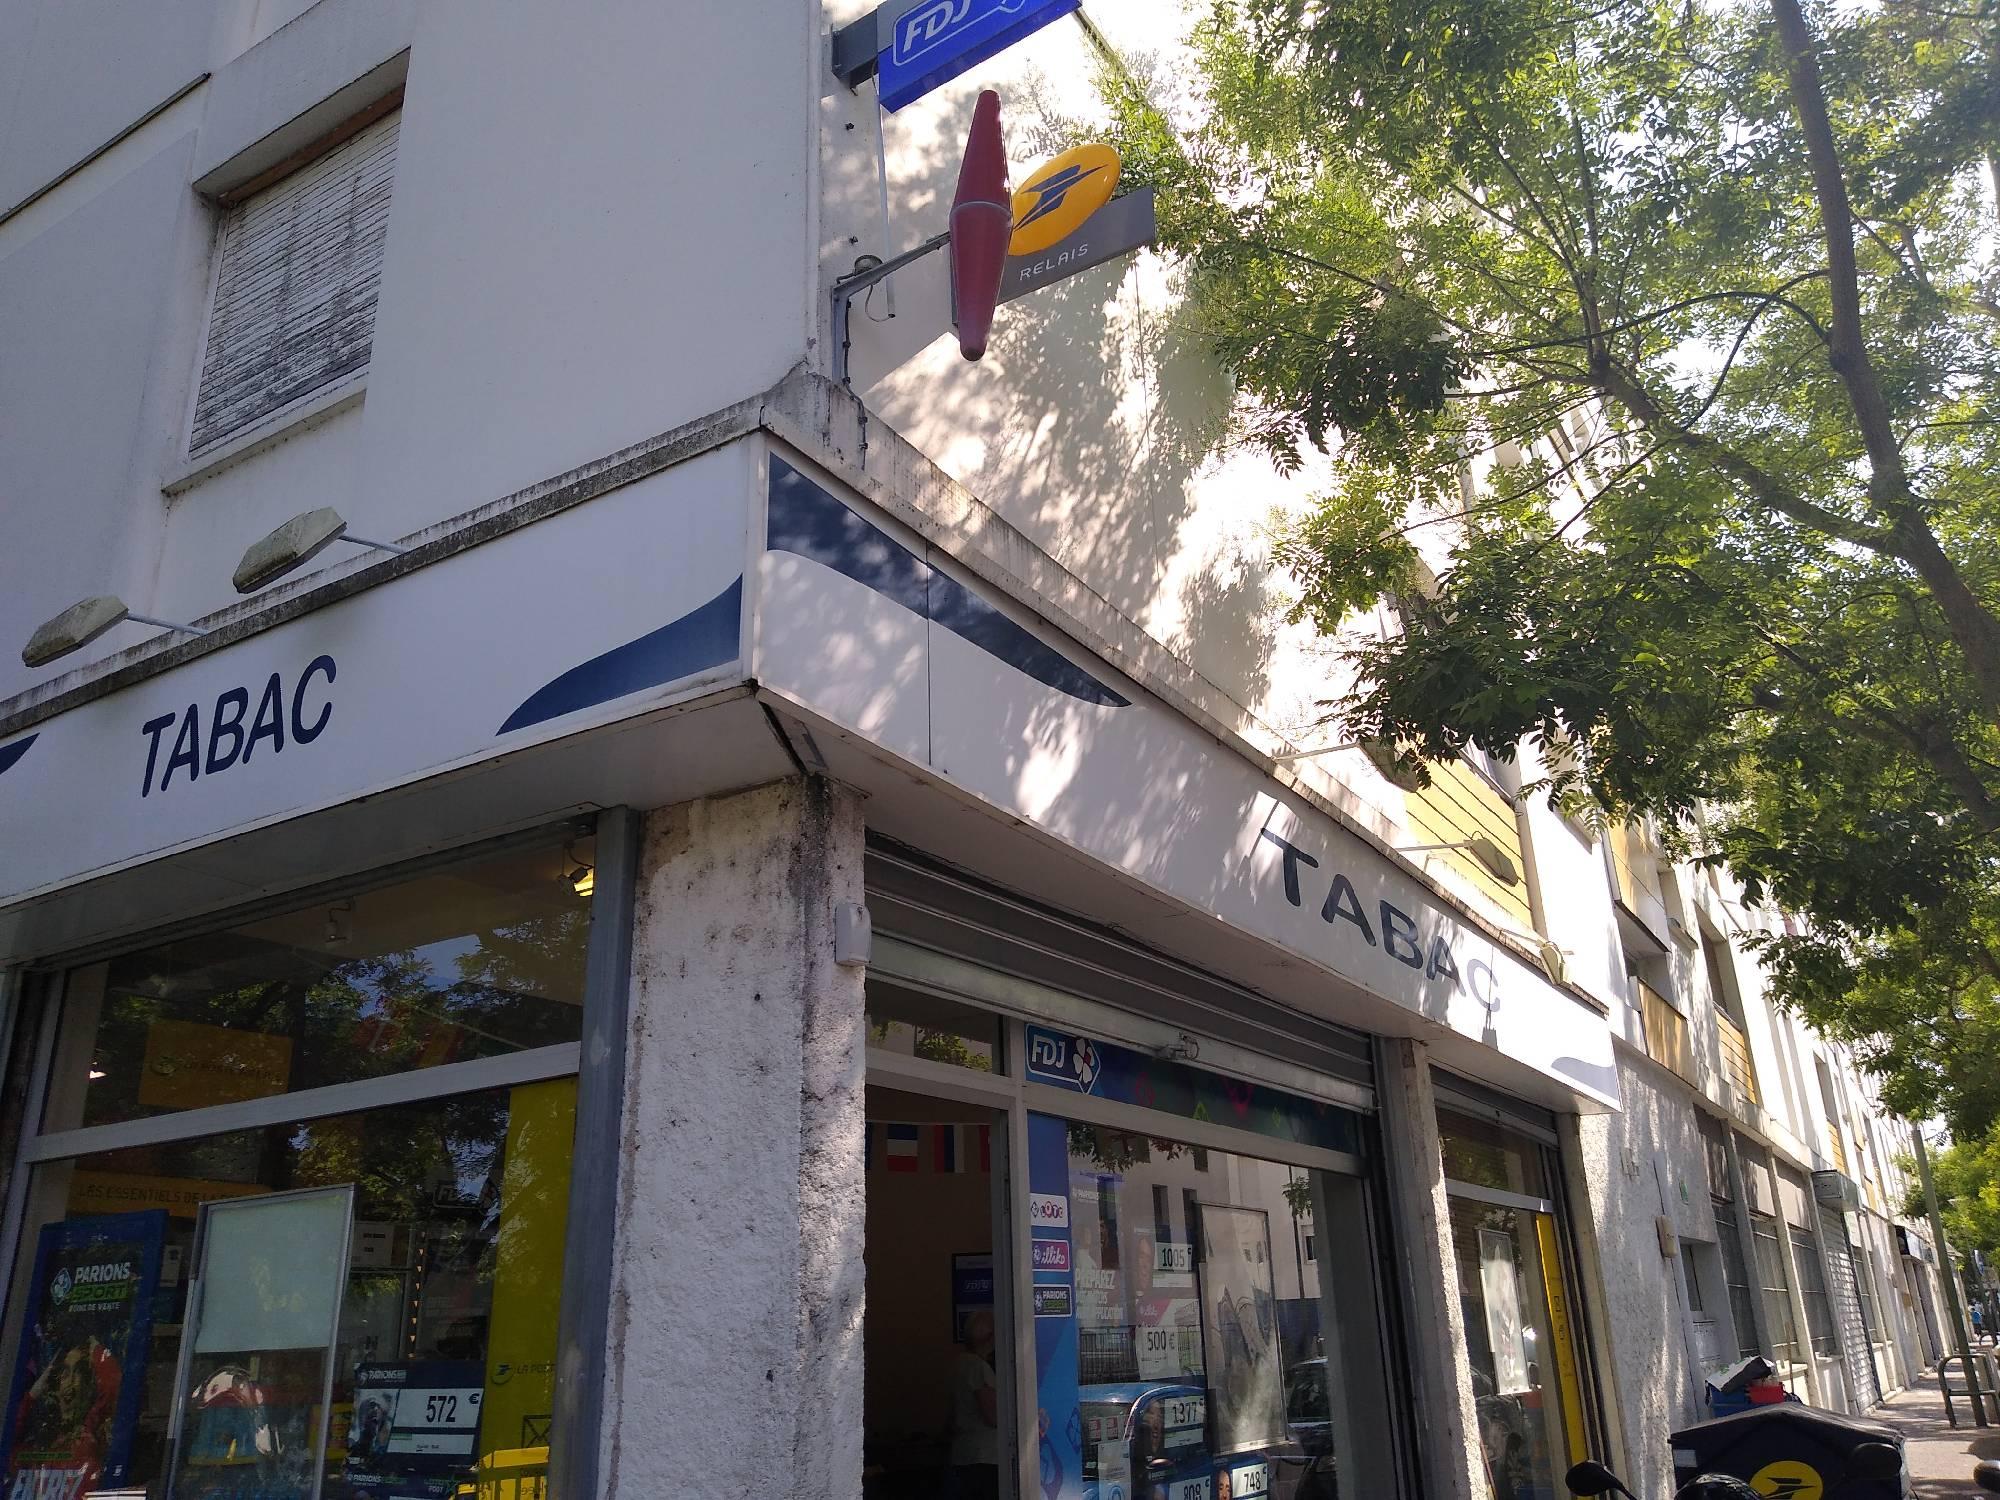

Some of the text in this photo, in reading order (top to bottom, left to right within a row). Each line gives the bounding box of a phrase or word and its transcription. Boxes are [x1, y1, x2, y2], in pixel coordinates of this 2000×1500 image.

[903, 0, 971, 53] FDJ
[1019, 243, 1088, 281] RELAIS
[142, 655, 337, 798] TABAC
[1261, 827, 1501, 1012] TABAC
[1031, 1034, 1066, 1069] FDJ
[1162, 1248, 1185, 1267] 1005
[74, 1262, 131, 1283] PARIONS
[1042, 1290, 1067, 1300] PARIONS
[1148, 1330, 1167, 1351] 500
[426, 1393, 480, 1423] 572 €
[1172, 1401, 1197, 1425] 1377
[1243, 1471, 1261, 1491] 748
